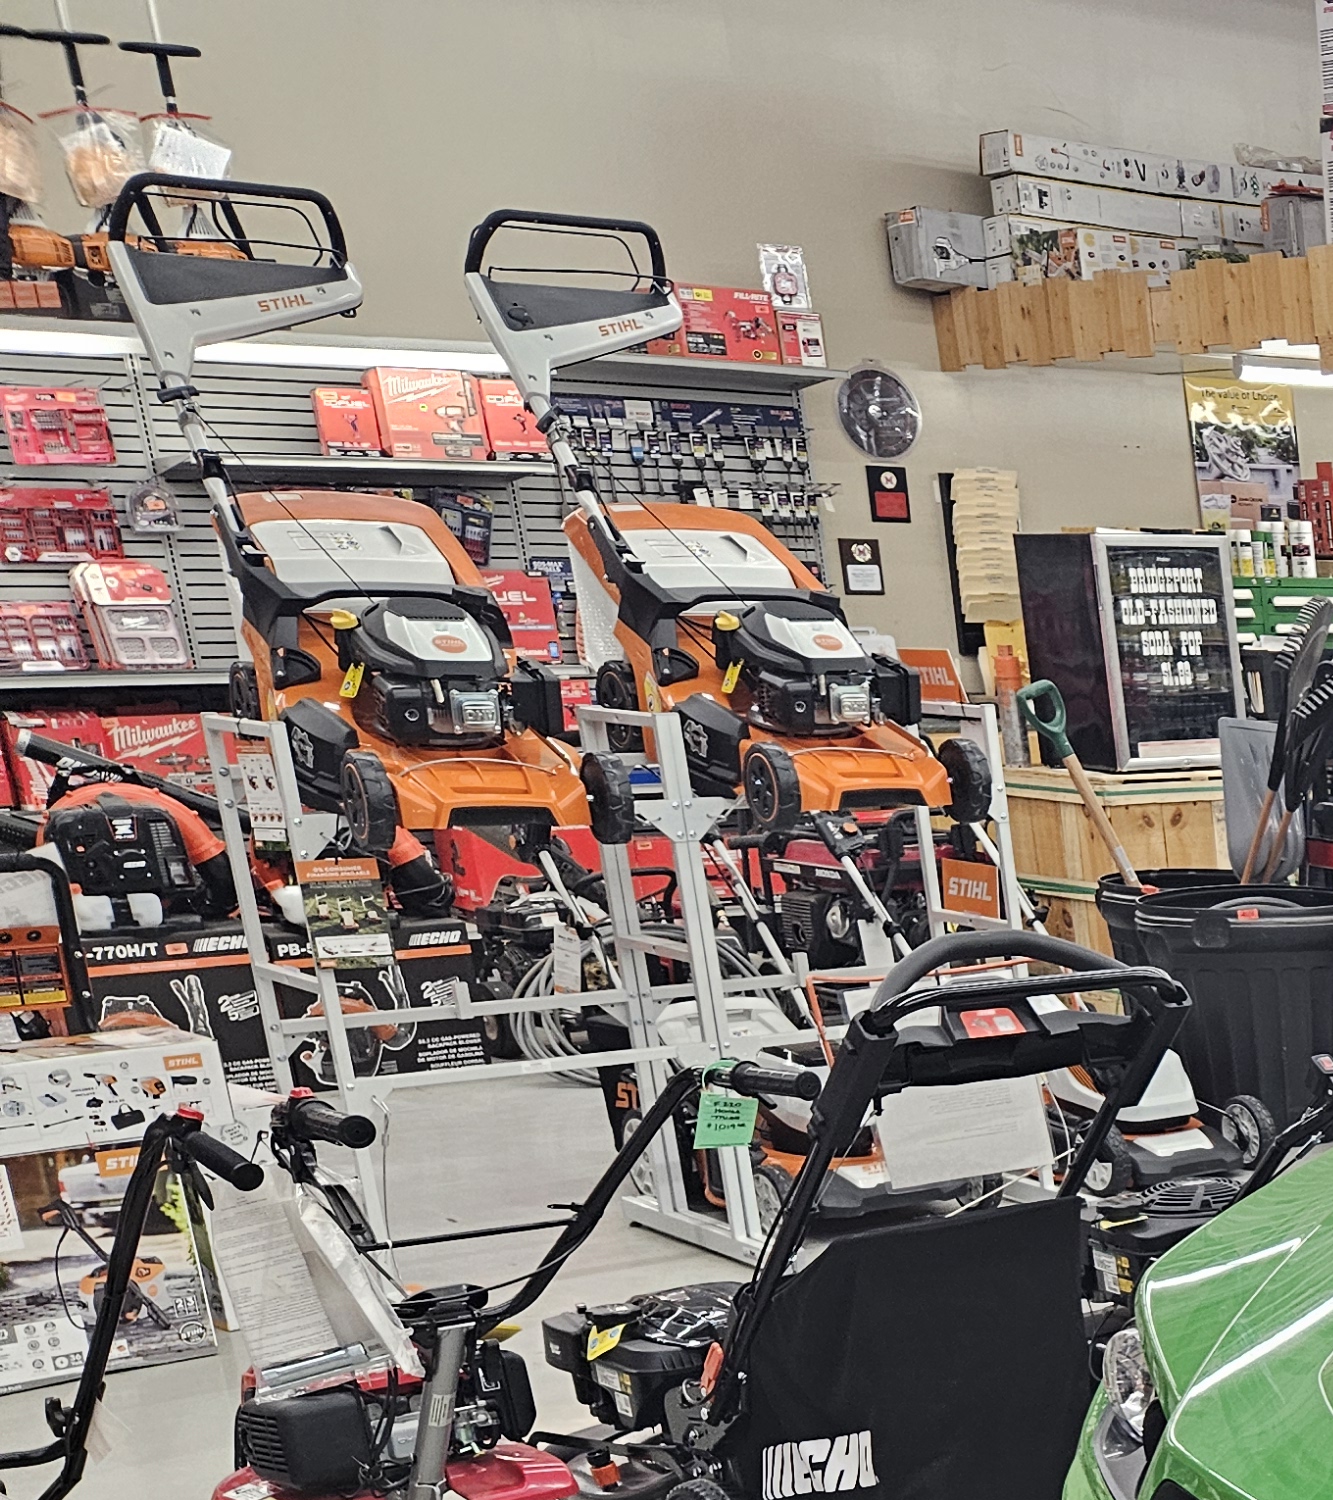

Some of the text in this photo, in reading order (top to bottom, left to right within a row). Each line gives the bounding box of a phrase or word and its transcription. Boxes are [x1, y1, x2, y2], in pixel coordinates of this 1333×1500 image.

[257, 293, 313, 313] STIHL
[733, 291, 771, 302] FILL-RITE
[598, 318, 644, 337] STIHL
[386, 374, 451, 397] Milwaukee
[1129, 567, 1203, 593] BRIDGEPORT
[492, 590, 537, 602] UEL
[1120, 599, 1218, 625] OLD-FASHIONED
[1141, 630, 1203, 656] SODA POP
[108, 717, 199, 751] Milwaukee
[948, 877, 992, 901] STIHL
[409, 930, 462, 946] ECHO
[86, 942, 158, 960] -770H/T
[167, 1057, 200, 1067] STIHL
[105, 1153, 136, 1170] STI
[762, 1429, 880, 1500] ECHO
